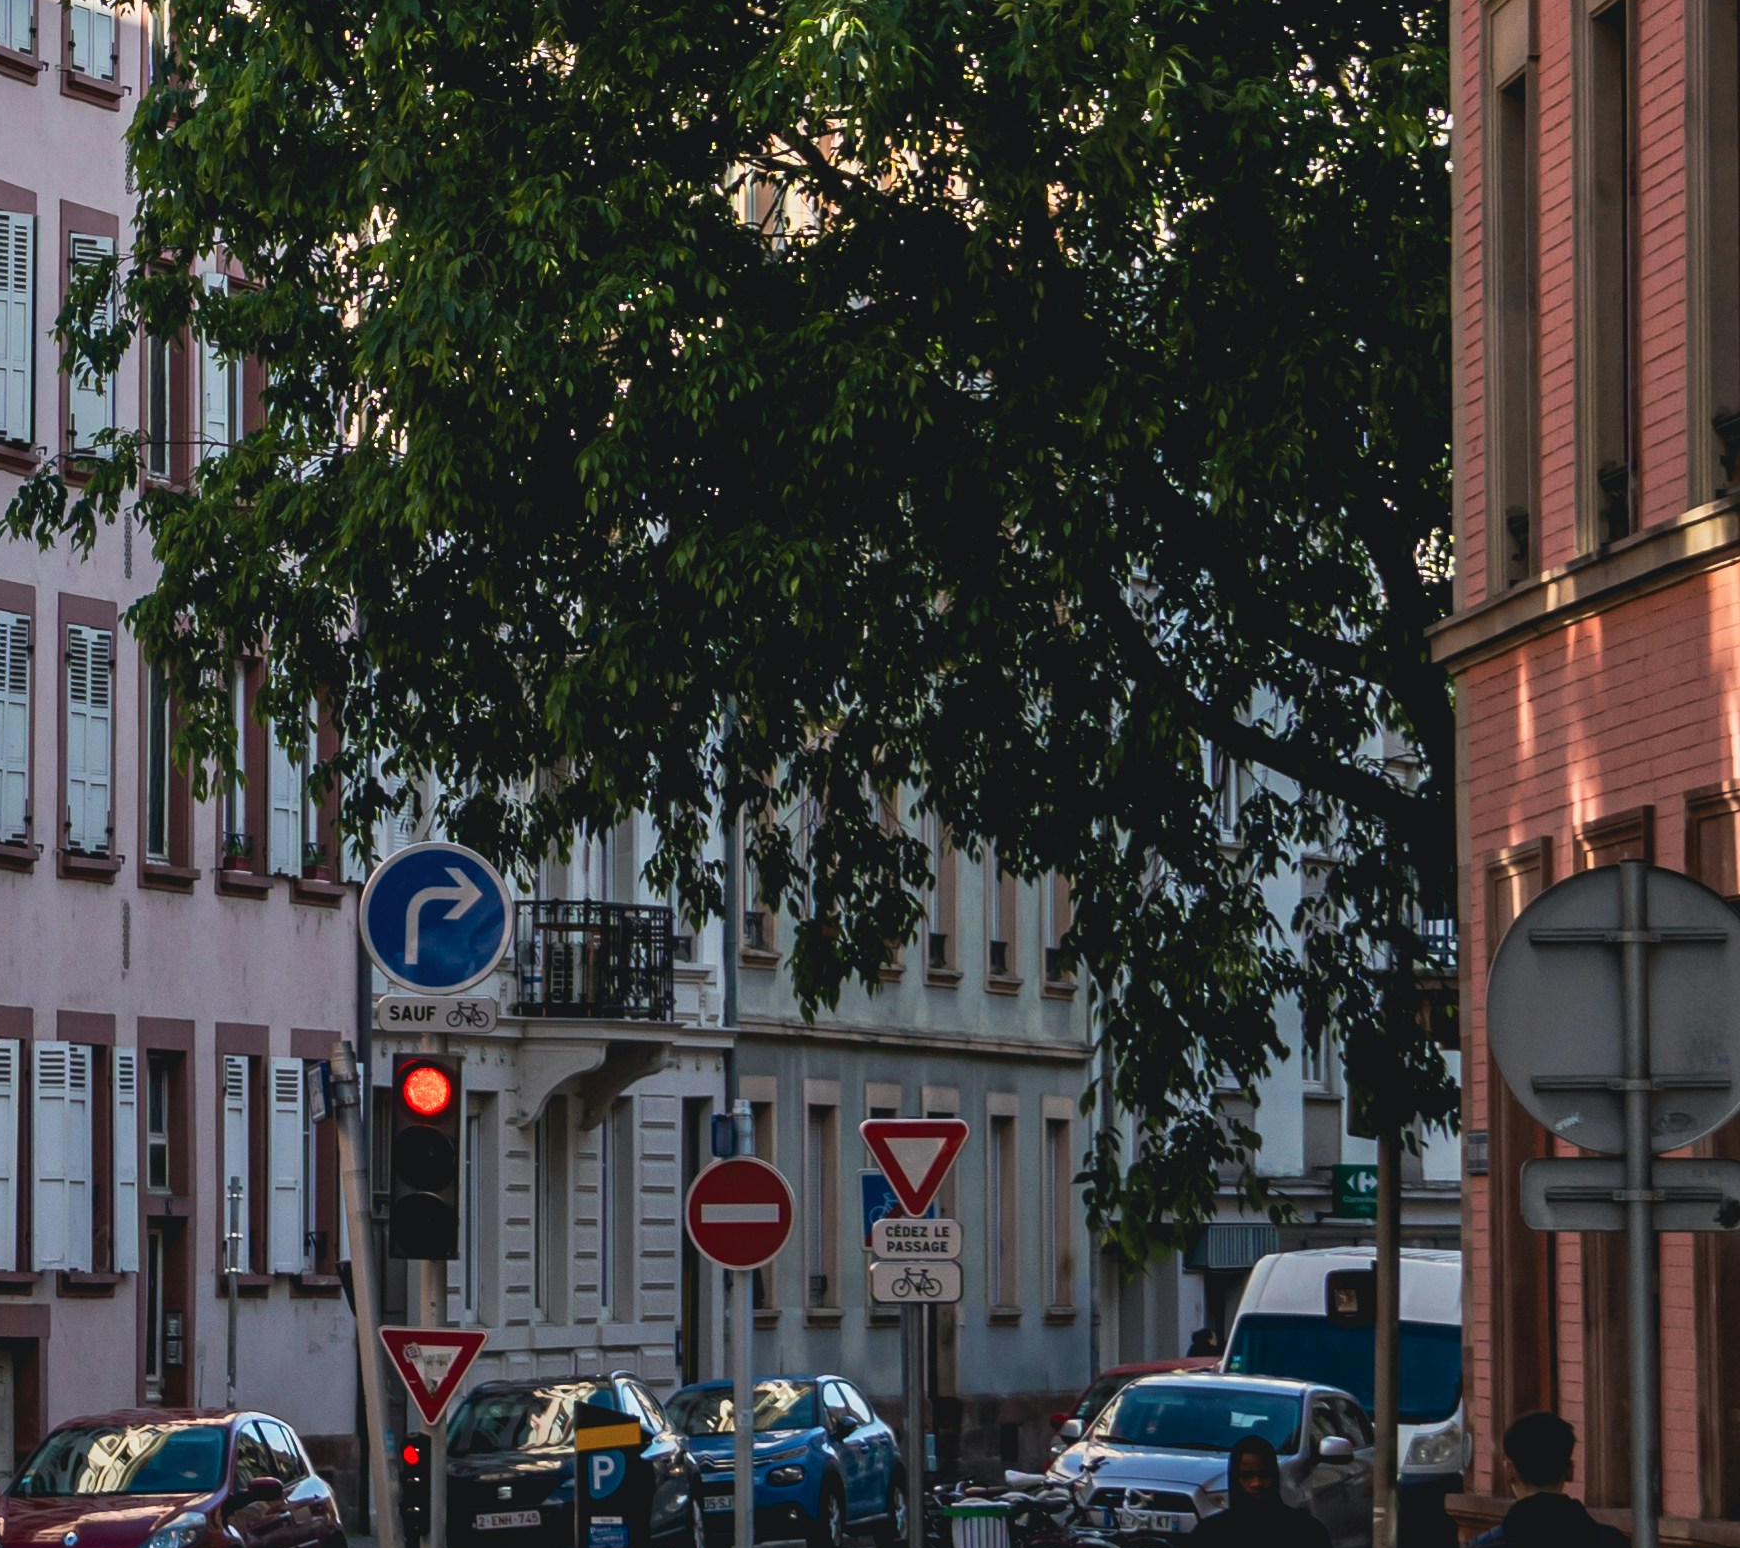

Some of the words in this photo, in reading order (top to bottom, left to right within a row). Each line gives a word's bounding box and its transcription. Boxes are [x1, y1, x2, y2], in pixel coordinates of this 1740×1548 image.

[389, 1005, 436, 1021] SAUF
[885, 1224, 928, 1238] CÉDEZ
[934, 1226, 950, 1238] LE
[886, 1240, 949, 1253] PASSAGE
[592, 1455, 615, 1490] P
